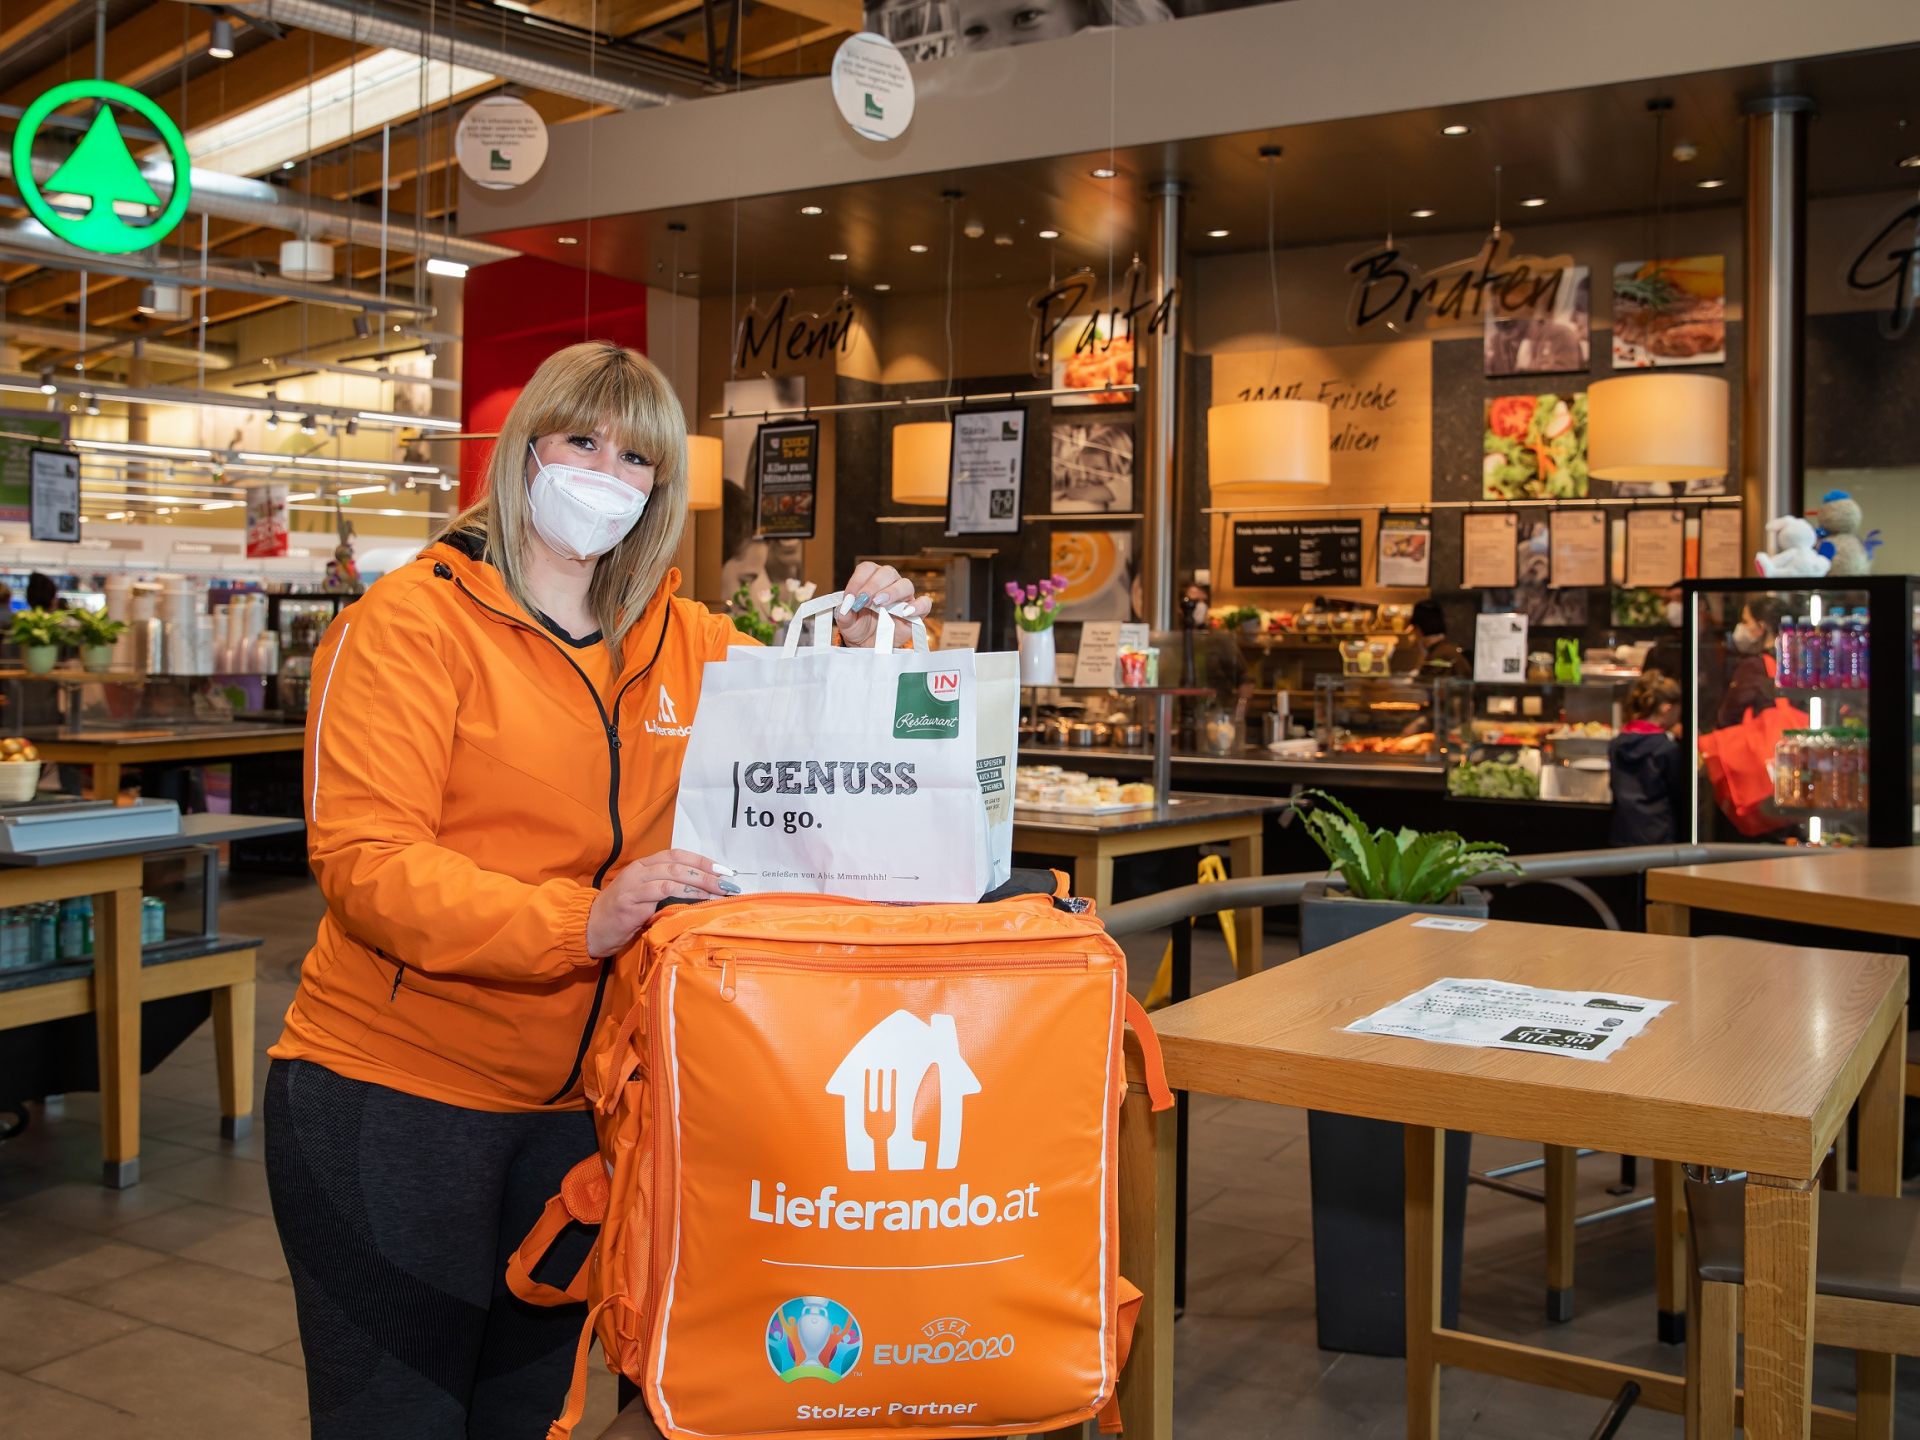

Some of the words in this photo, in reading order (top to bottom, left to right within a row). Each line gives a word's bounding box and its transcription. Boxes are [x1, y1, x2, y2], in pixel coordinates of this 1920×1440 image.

[1351, 239, 1564, 327] Braten
[741, 295, 854, 369] Menü
[1038, 270, 1176, 367] Pasta
[934, 674, 958, 690] IN
[896, 713, 959, 729] Restaurant
[744, 761, 918, 795] GENUSS
[744, 806, 775, 827] to
[783, 811, 822, 834] go.
[761, 870, 799, 878] Genießen
[750, 1179, 1040, 1231] Lieferando.at
[924, 1321, 967, 1337] UEFA
[873, 1334, 1015, 1365] EURO2020
[797, 1404, 882, 1420] Stolzer
[888, 1402, 978, 1416] Partner
